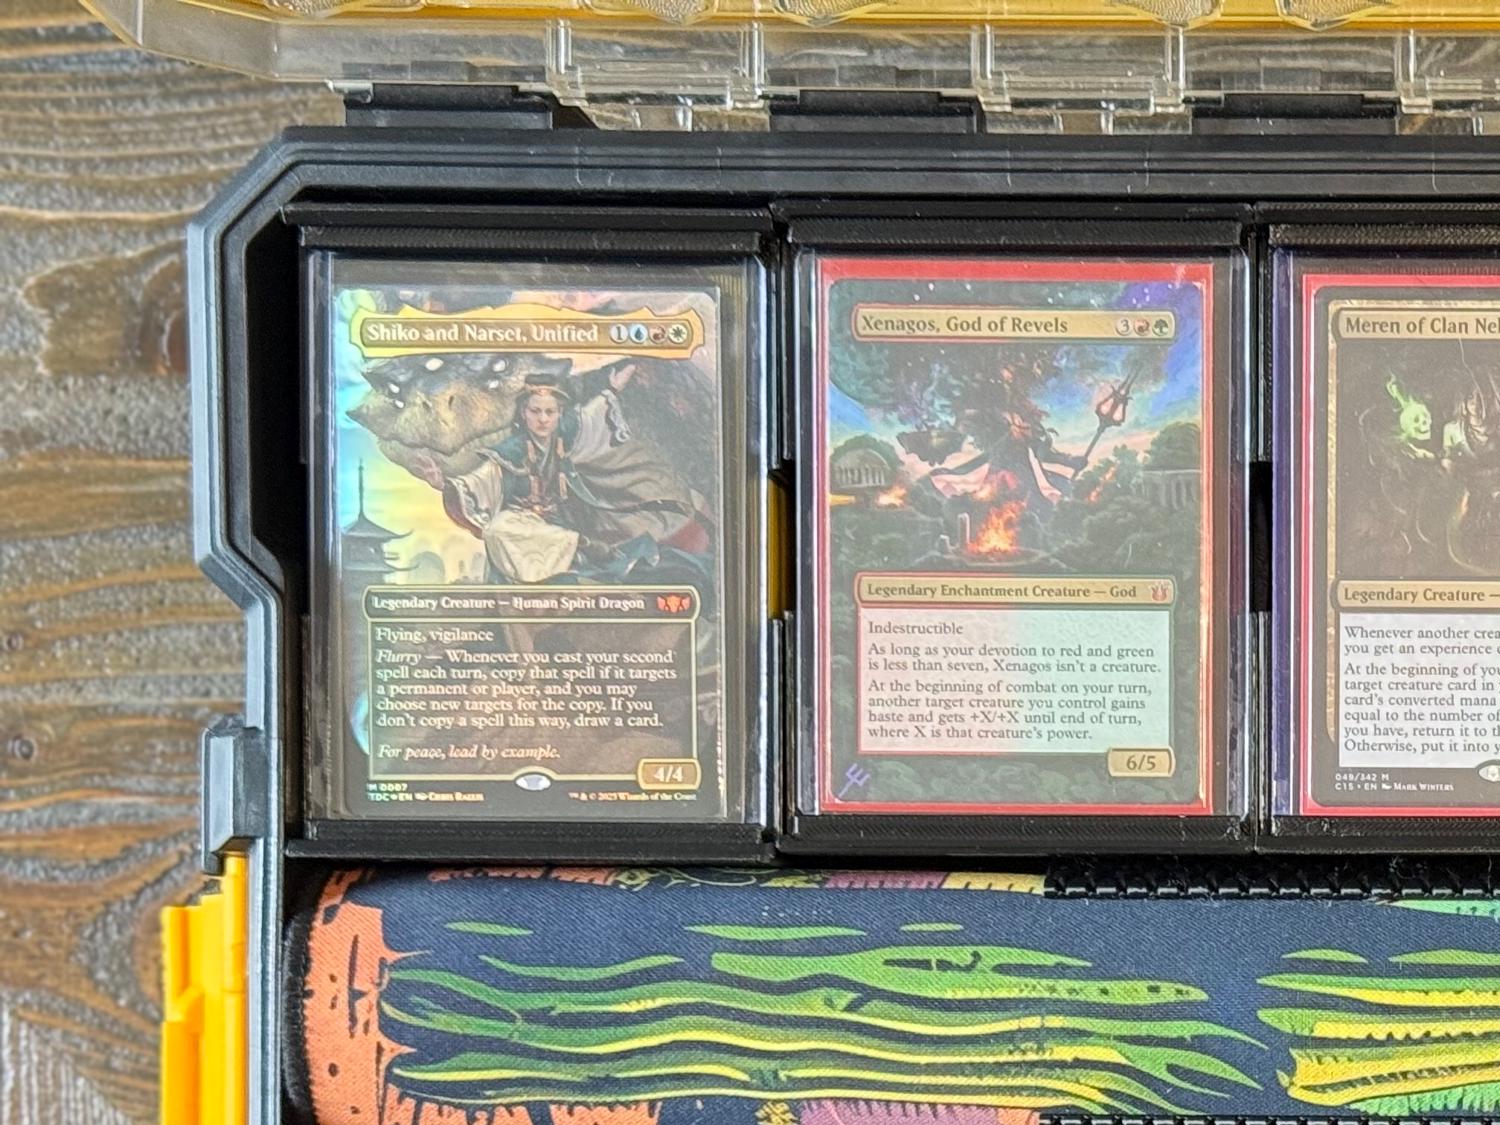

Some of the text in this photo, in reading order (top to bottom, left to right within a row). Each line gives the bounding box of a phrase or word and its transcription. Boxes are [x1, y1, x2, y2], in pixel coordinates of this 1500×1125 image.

[367, 324, 599, 343] Shiko and Narset, Unified
[859, 316, 1067, 337] Xenagos, God of Revels
[1346, 317, 1400, 334] Meren
[1406, 317, 1425, 334] of
[1430, 317, 1468, 334] Clan
[868, 585, 1136, 601] Legendary Enchantment Creature God
[1344, 588, 1417, 605] Legendary
[1423, 588, 1484, 601] Creature
[372, 597, 644, 612] Legendary Creature Human Spirit Dragon
[375, 628, 493, 644] Flying, vigilance
[869, 622, 962, 634] Indestructible
[1345, 627, 1412, 640] Whenever
[1417, 627, 1469, 640] another
[375, 649, 675, 666] Flurry Whenever you cast your second
[868, 645, 1153, 661] As long as your devotion to red and green
[1344, 646, 1368, 659] you
[1374, 644, 1393, 659] get
[1398, 646, 1414, 655] an
[1420, 644, 1491, 659] experience
[376, 666, 676, 682] spell each turn, copy that spell if it targets
[868, 661, 1160, 676] is less than seven, Xenagos isn't a creature.
[1344, 662, 1360, 675] At
[1365, 662, 1386, 675] the
[1391, 662, 1458, 679] beginning
[1463, 662, 1478, 675] of
[378, 744, 559, 761] For peace, lead by example.
[1344, 739, 1416, 753] Otherwise,
[1421, 741, 1444, 755] put
[1449, 741, 1458, 752] it
[1463, 741, 1489, 752] into
[1126, 754, 1156, 772] 6/5
[652, 766, 683, 783] 4/4
